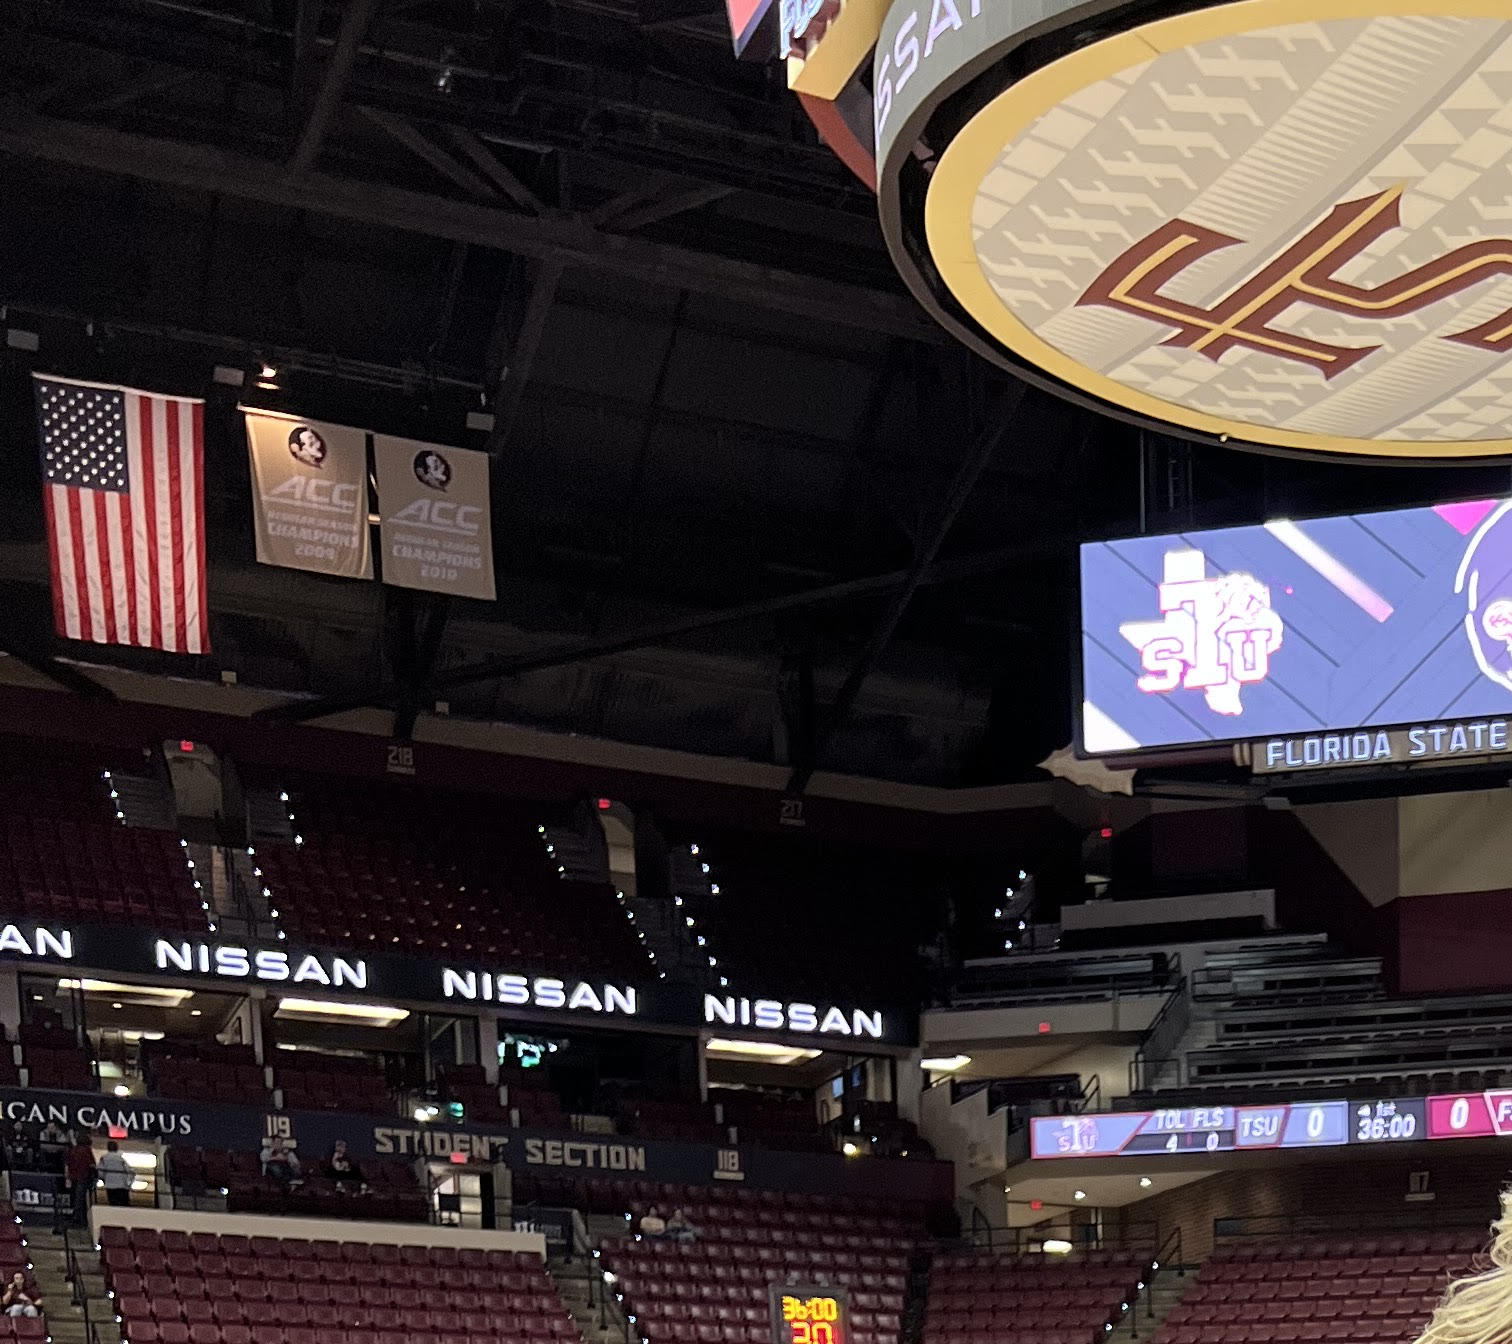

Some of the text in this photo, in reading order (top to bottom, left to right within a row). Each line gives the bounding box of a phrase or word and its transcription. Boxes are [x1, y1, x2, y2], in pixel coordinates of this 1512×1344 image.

[264, 475, 358, 509] ACC
[390, 499, 484, 532] ACC
[391, 545, 481, 569] CHAMPIONS
[1266, 721, 1509, 768] FLORIDA STATE
[156, 940, 367, 989] NISSAN
[443, 969, 636, 1015] NISSAN
[705, 994, 883, 1038] NISSAN
[77, 1106, 192, 1135] CAMPUS
[266, 1115, 291, 1138] 119
[1156, 1107, 1224, 1130] TOL FLS
[1241, 1116, 1279, 1137] TSU
[1307, 1108, 1325, 1138] 0
[1357, 1114, 1416, 1140] 36:00
[1450, 1098, 1470, 1129] 0
[524, 1138, 646, 1172] SECTION
[1166, 1131, 1220, 1153] 4 0
[782, 1296, 838, 1321] 36:00
